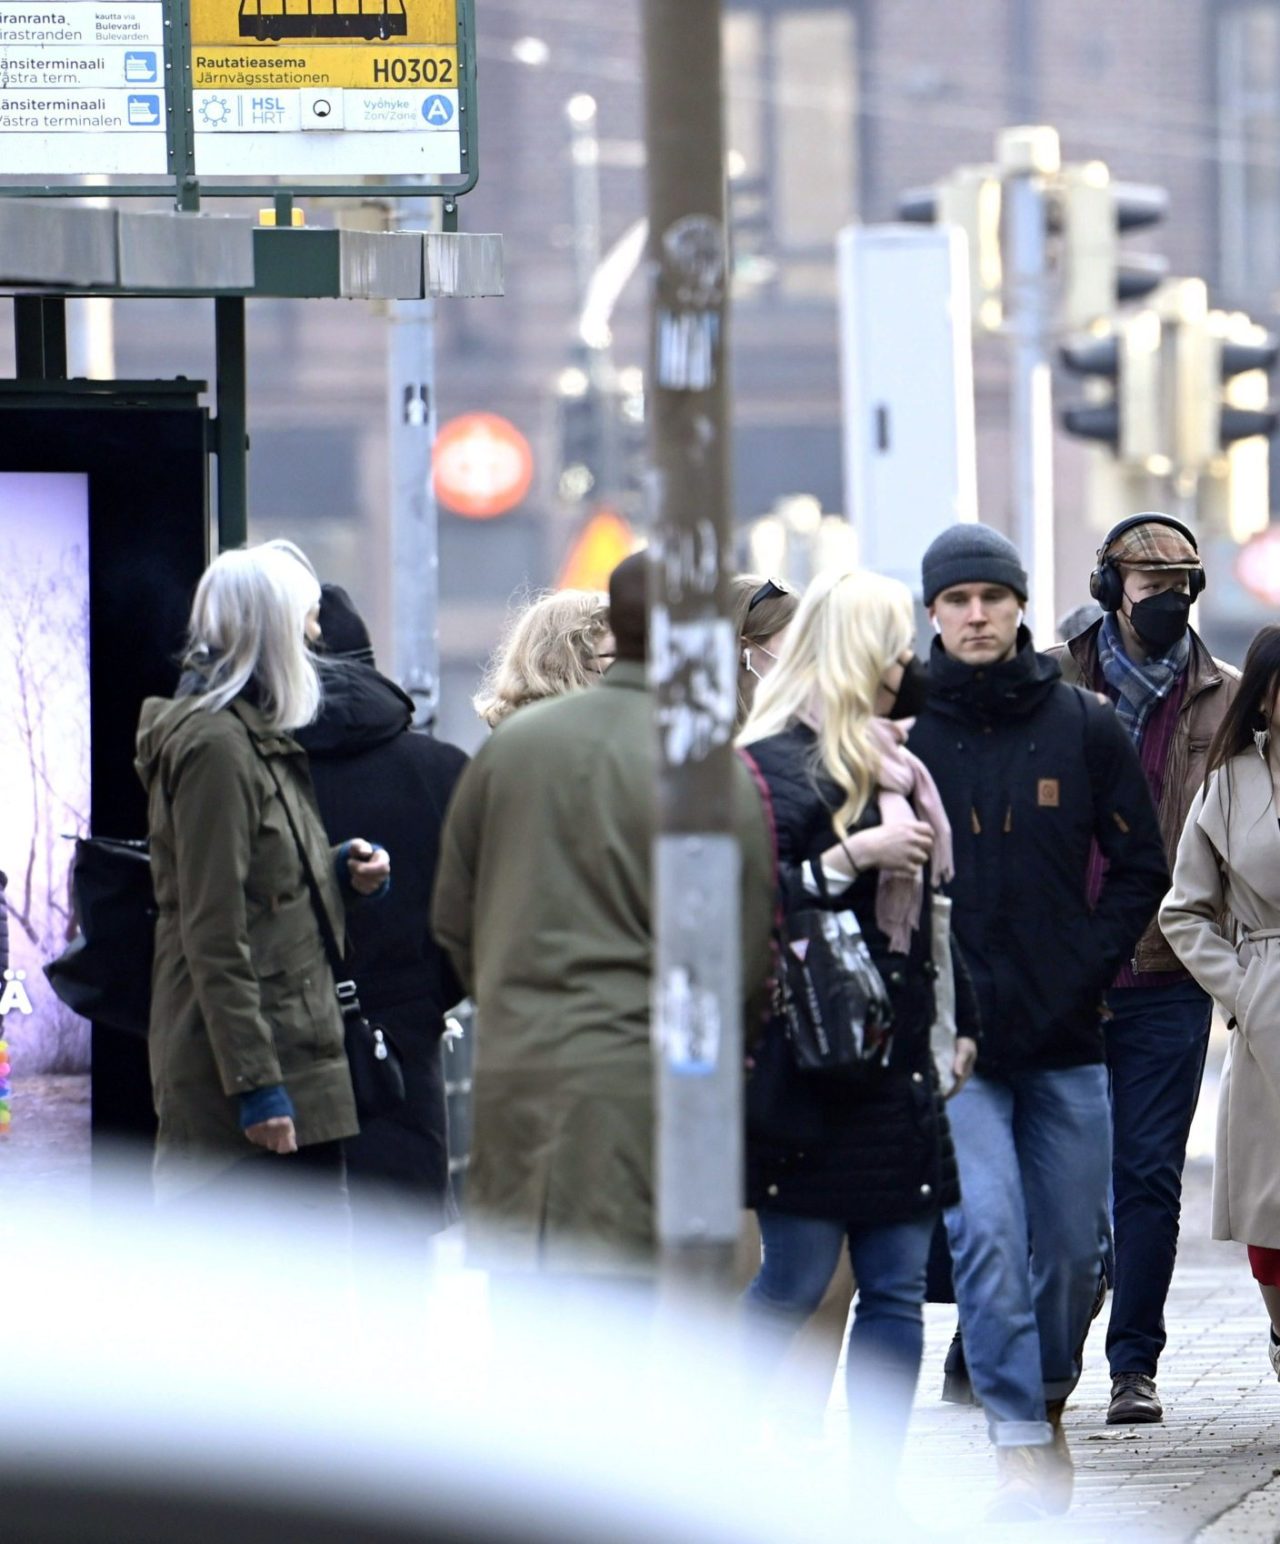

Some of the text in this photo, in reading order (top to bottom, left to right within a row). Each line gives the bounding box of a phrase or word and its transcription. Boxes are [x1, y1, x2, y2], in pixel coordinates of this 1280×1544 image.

[95, 12, 122, 20] kautta
[95, 22, 141, 30] Bulevardi
[95, 32, 150, 41] Bulevarden
[196, 56, 306, 68] Rautatieasema
[0, 71, 81, 83] ästra term.
[373, 58, 453, 83] H0302
[196, 71, 330, 85] Järnvägsstationen
[0, 98, 106, 111] änsiterminaali
[252, 97, 286, 110] HSL
[363, 97, 410, 110] Vyöhyke
[426, 97, 450, 121] A
[0, 114, 122, 127] ästra terminalen
[252, 111, 286, 124] HRT
